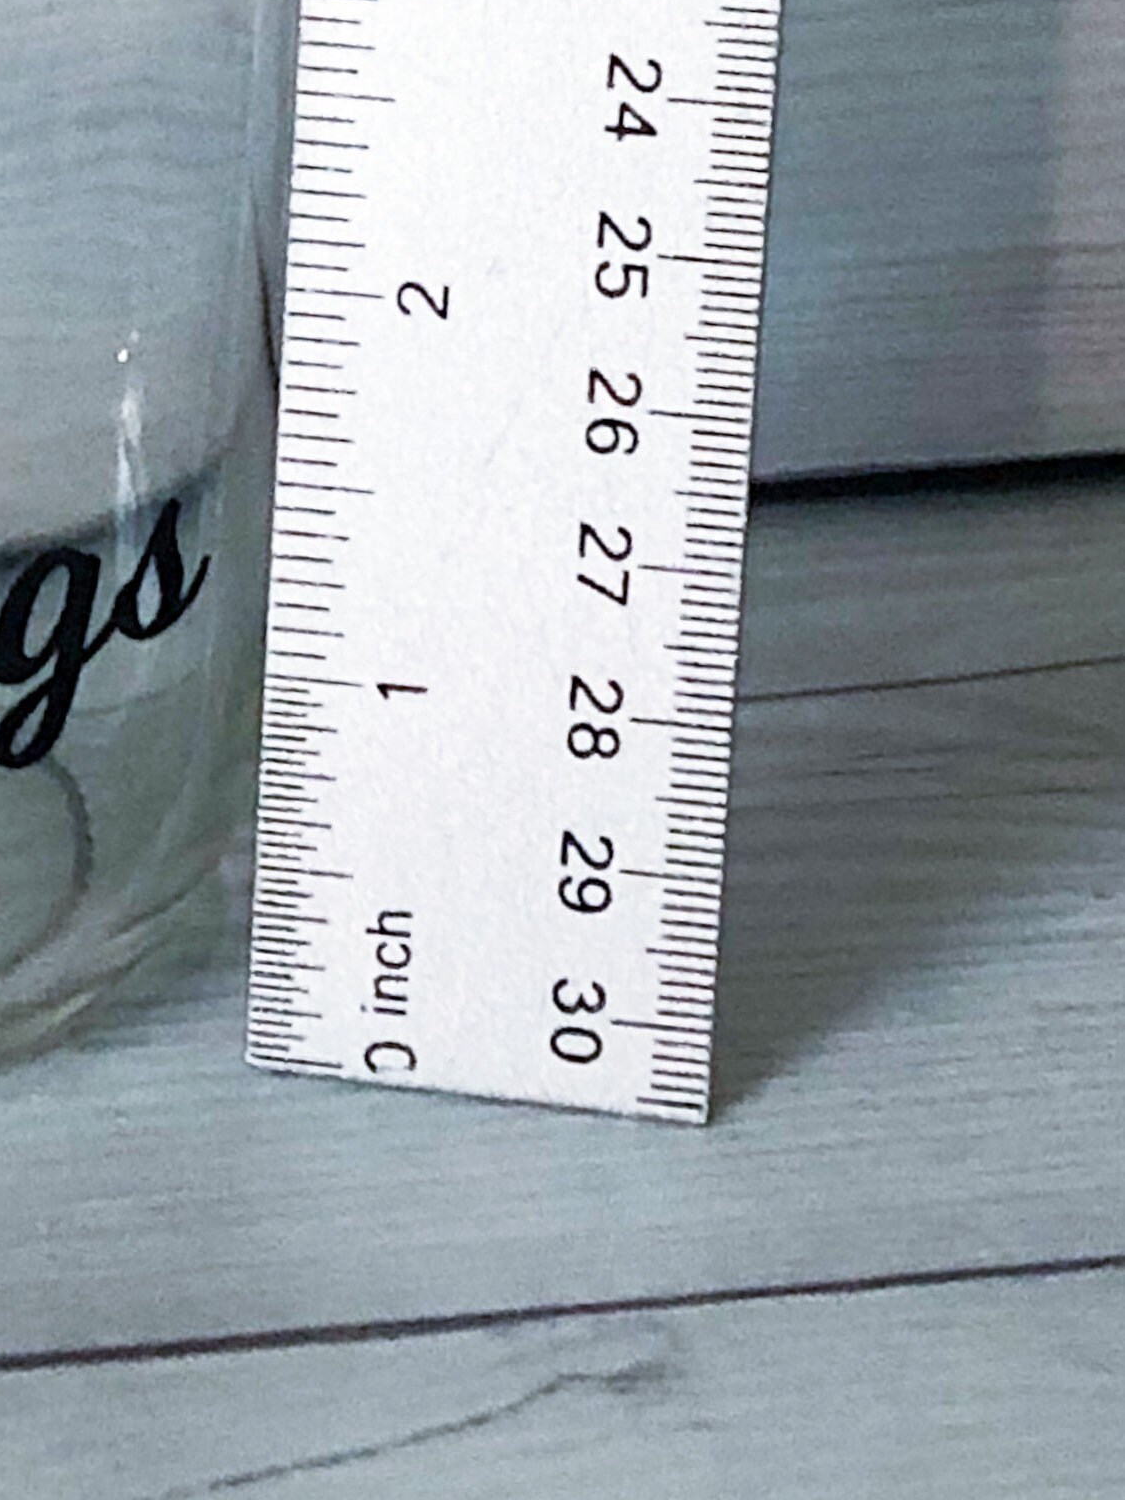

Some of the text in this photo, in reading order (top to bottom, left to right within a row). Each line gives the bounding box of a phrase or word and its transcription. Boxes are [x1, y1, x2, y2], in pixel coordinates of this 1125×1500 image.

[603, 52, 663, 143] 24
[593, 210, 653, 300] 25
[396, 280, 451, 321] 2
[584, 367, 644, 456] 26
[576, 521, 634, 608] 27
[375, 681, 429, 701] 1
[565, 674, 625, 761] 28
[556, 829, 615, 915] 29
[359, 909, 414, 1017] inch
[548, 977, 608, 1066] 30
